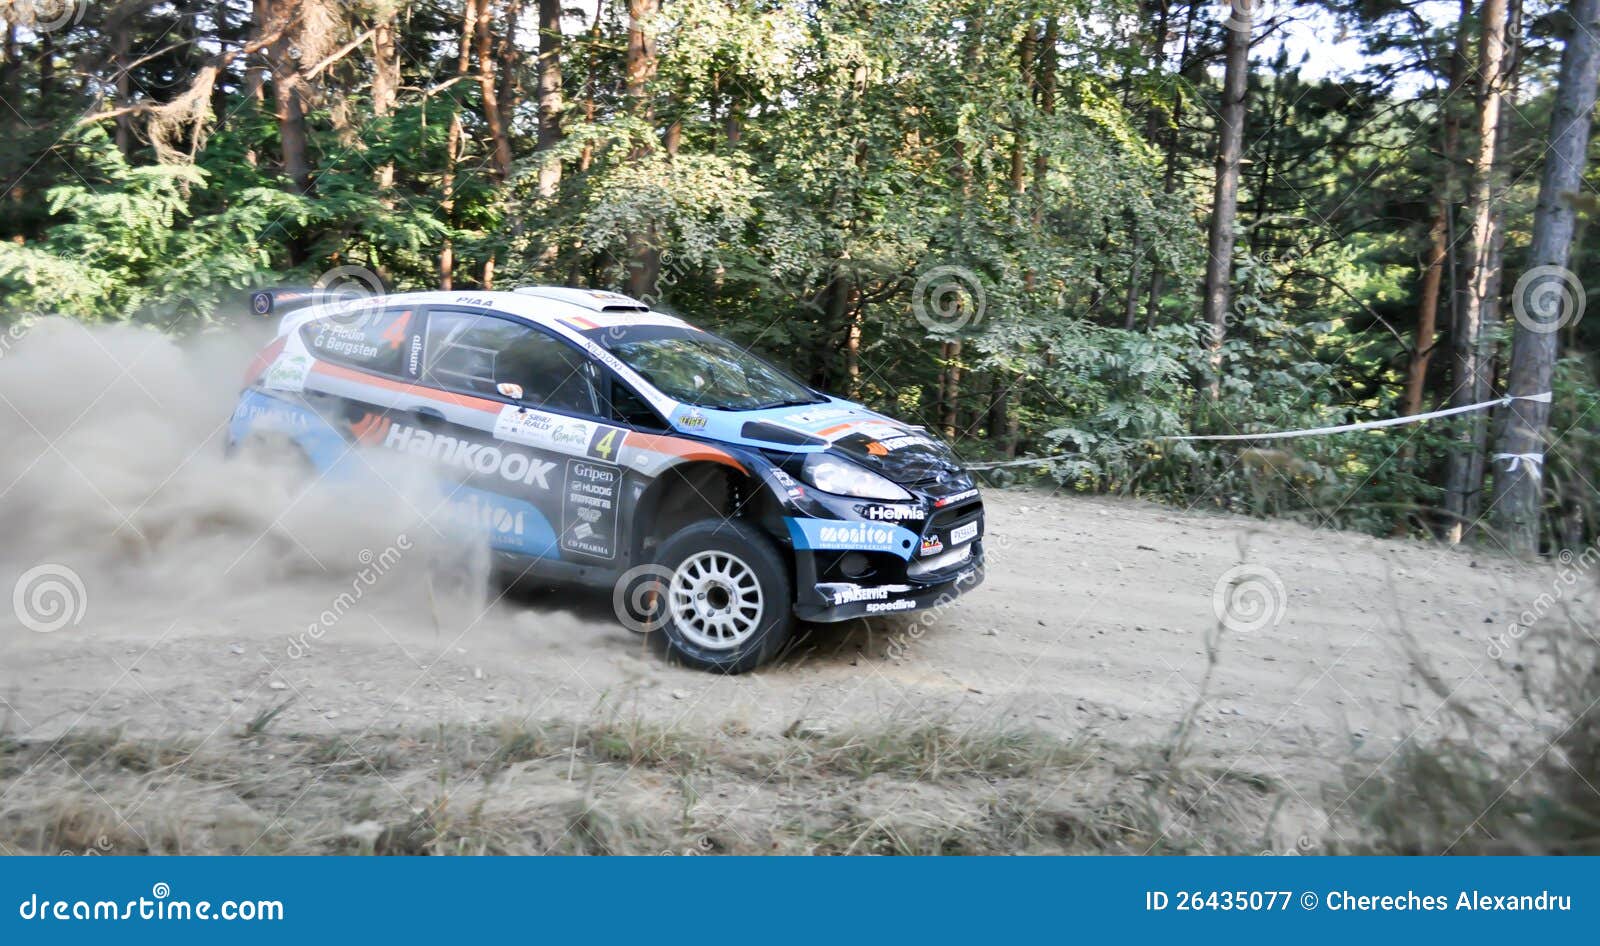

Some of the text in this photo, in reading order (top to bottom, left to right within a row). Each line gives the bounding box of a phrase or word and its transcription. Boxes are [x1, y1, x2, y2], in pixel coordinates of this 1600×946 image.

[456, 296, 493, 308] PIAA
[383, 310, 413, 349] 4
[314, 335, 378, 358] G Bergsten
[523, 418, 552, 431] RALLY
[595, 429, 618, 459] 4
[574, 464, 614, 482] Gripen
[582, 483, 612, 497] HUDDIG
[819, 523, 895, 544] monitor
[579, 541, 609, 555] PHARMA
[866, 599, 917, 613] speedline
